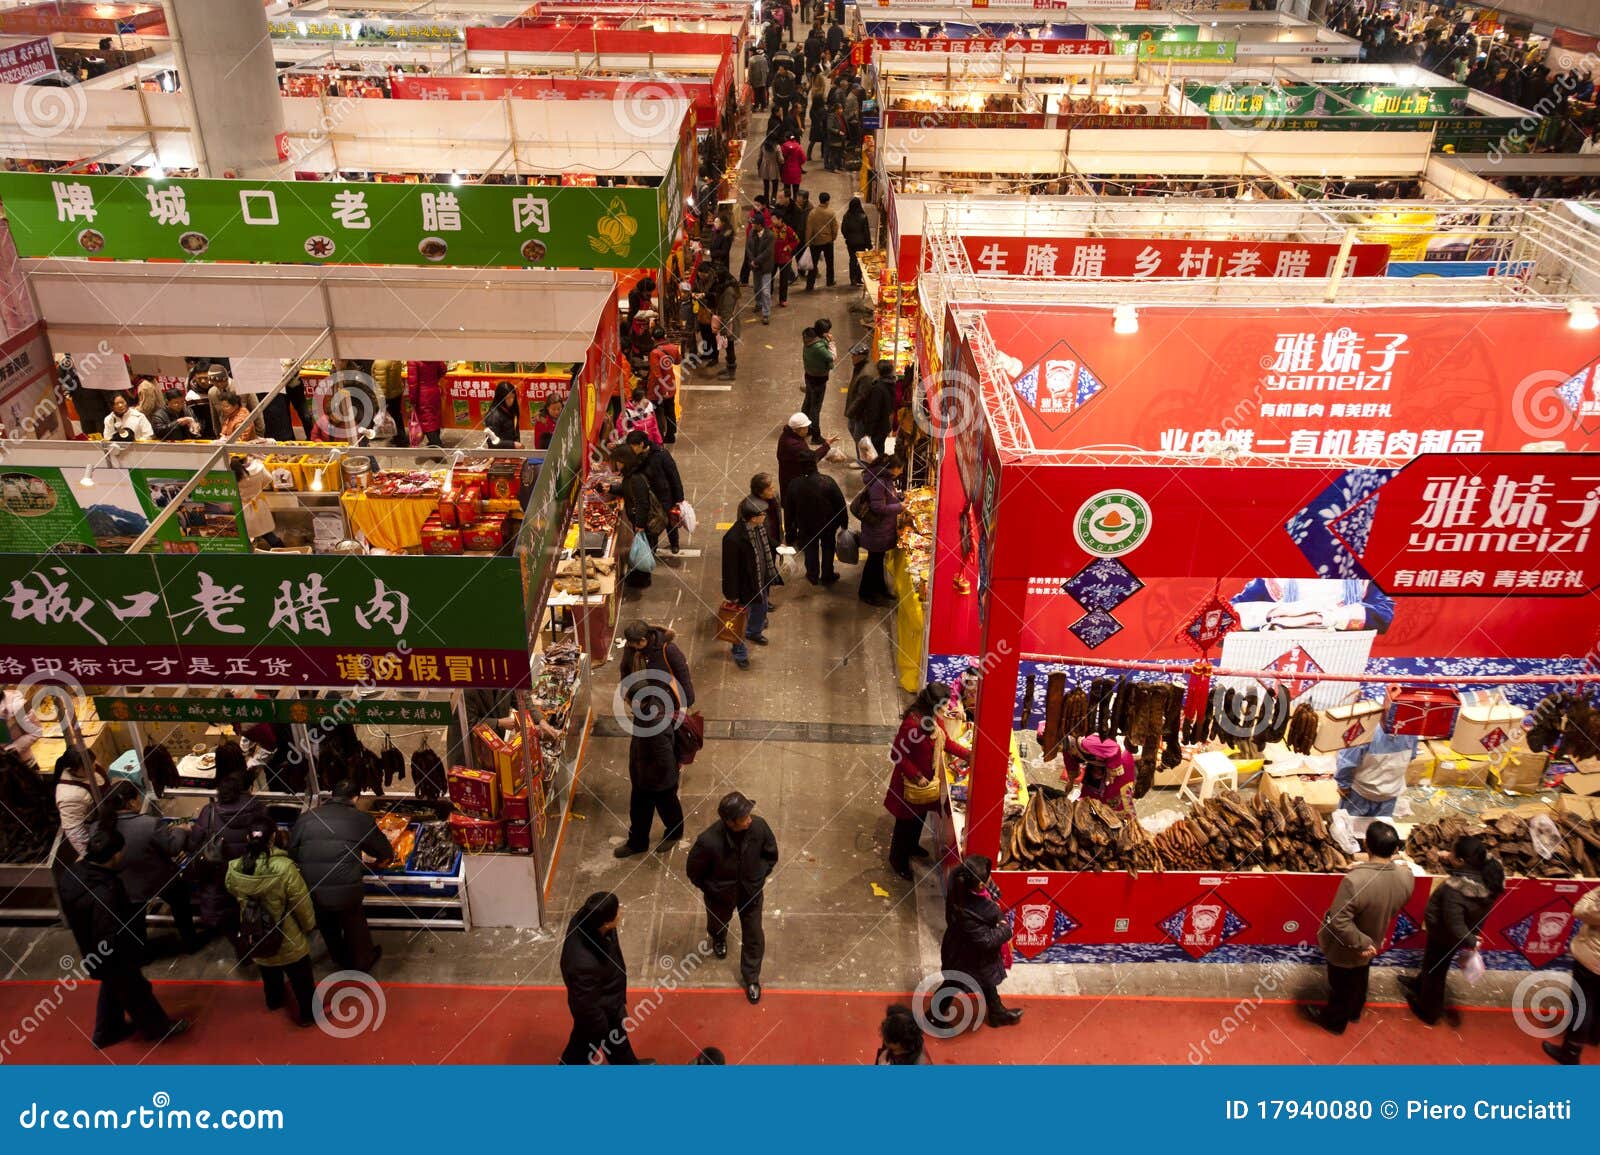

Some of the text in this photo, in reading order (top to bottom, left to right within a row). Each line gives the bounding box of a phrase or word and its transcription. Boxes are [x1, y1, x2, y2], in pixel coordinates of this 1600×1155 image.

[51, 180, 551, 234] 牌城口老腊肉
[1272, 331, 1409, 373] 雅妹子
[1266, 371, 1392, 392] yameizi
[1406, 527, 1591, 553] yameizi
[1393, 568, 1486, 588] 有机酱肉
[2, 566, 410, 646] 城口老腊肉
